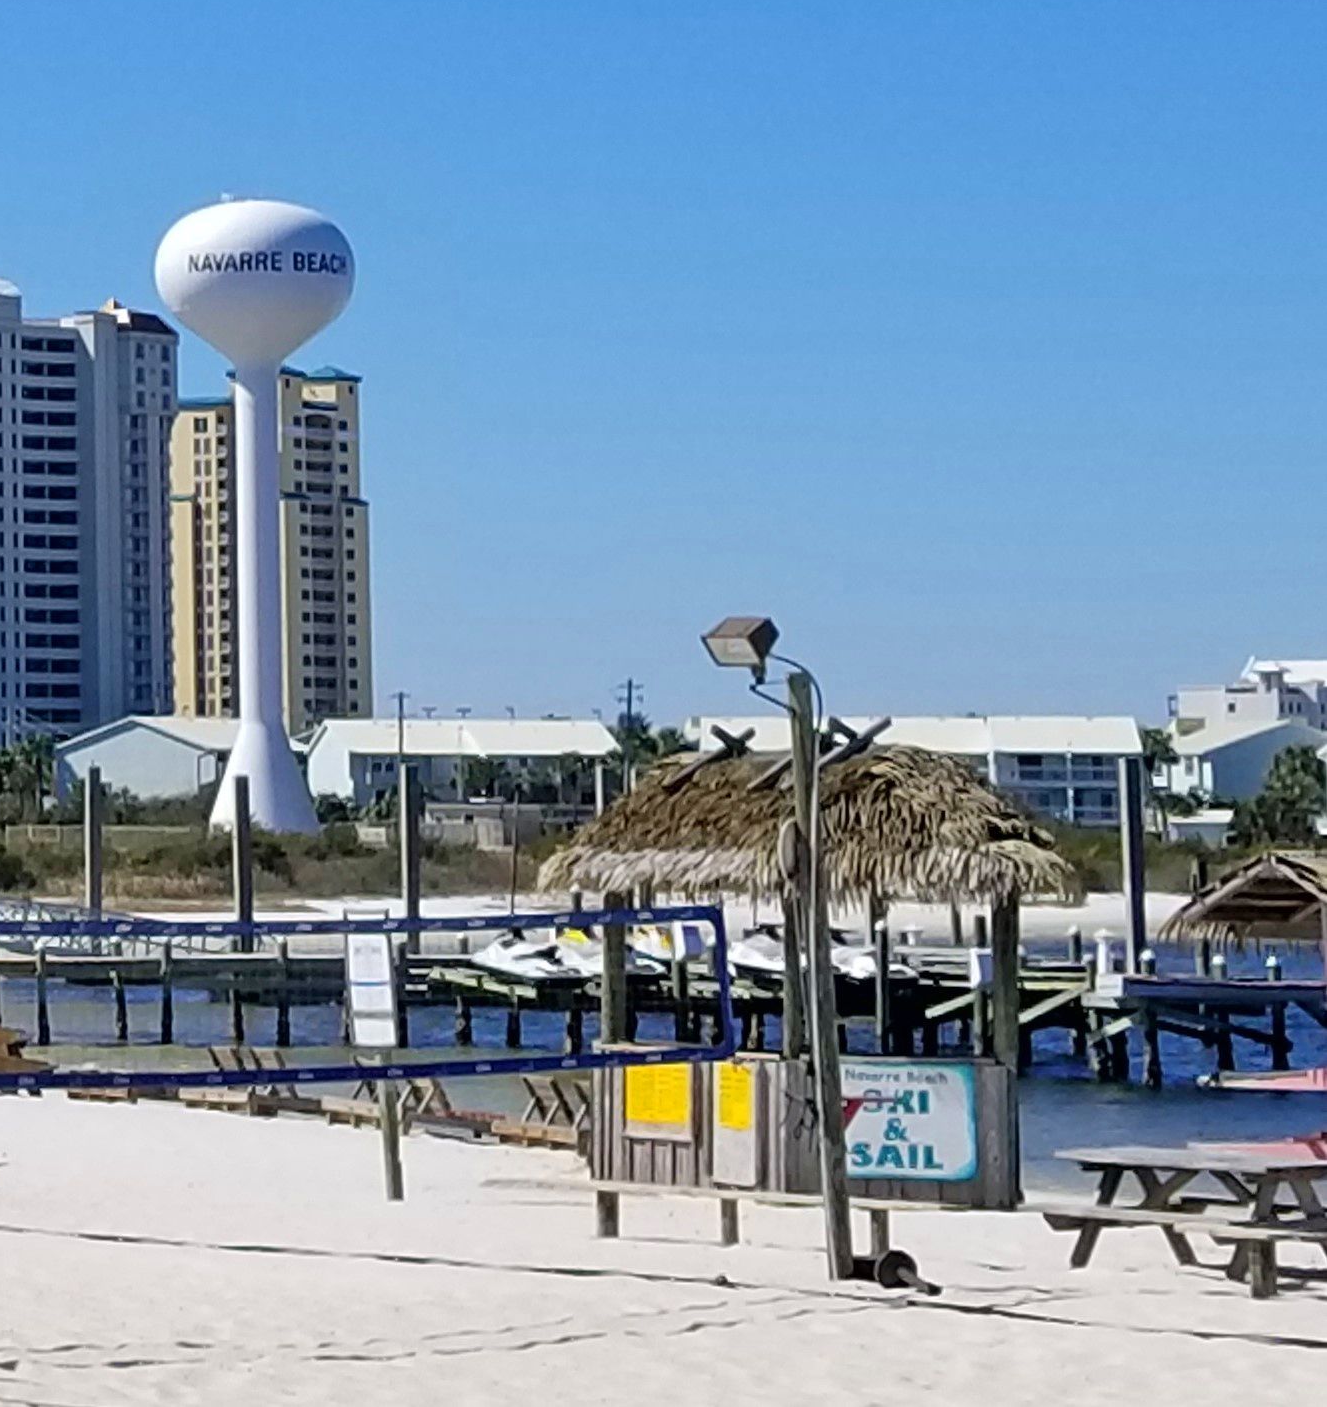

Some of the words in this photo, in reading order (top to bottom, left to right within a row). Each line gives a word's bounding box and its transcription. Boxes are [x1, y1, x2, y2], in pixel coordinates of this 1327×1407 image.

[188, 252, 282, 273] NAVARRE
[293, 252, 347, 275] BEACH
[845, 1069, 900, 1082] Navarre
[863, 1089, 930, 1114] SKI
[883, 1118, 908, 1141] &
[850, 1142, 944, 1169] SAIL
